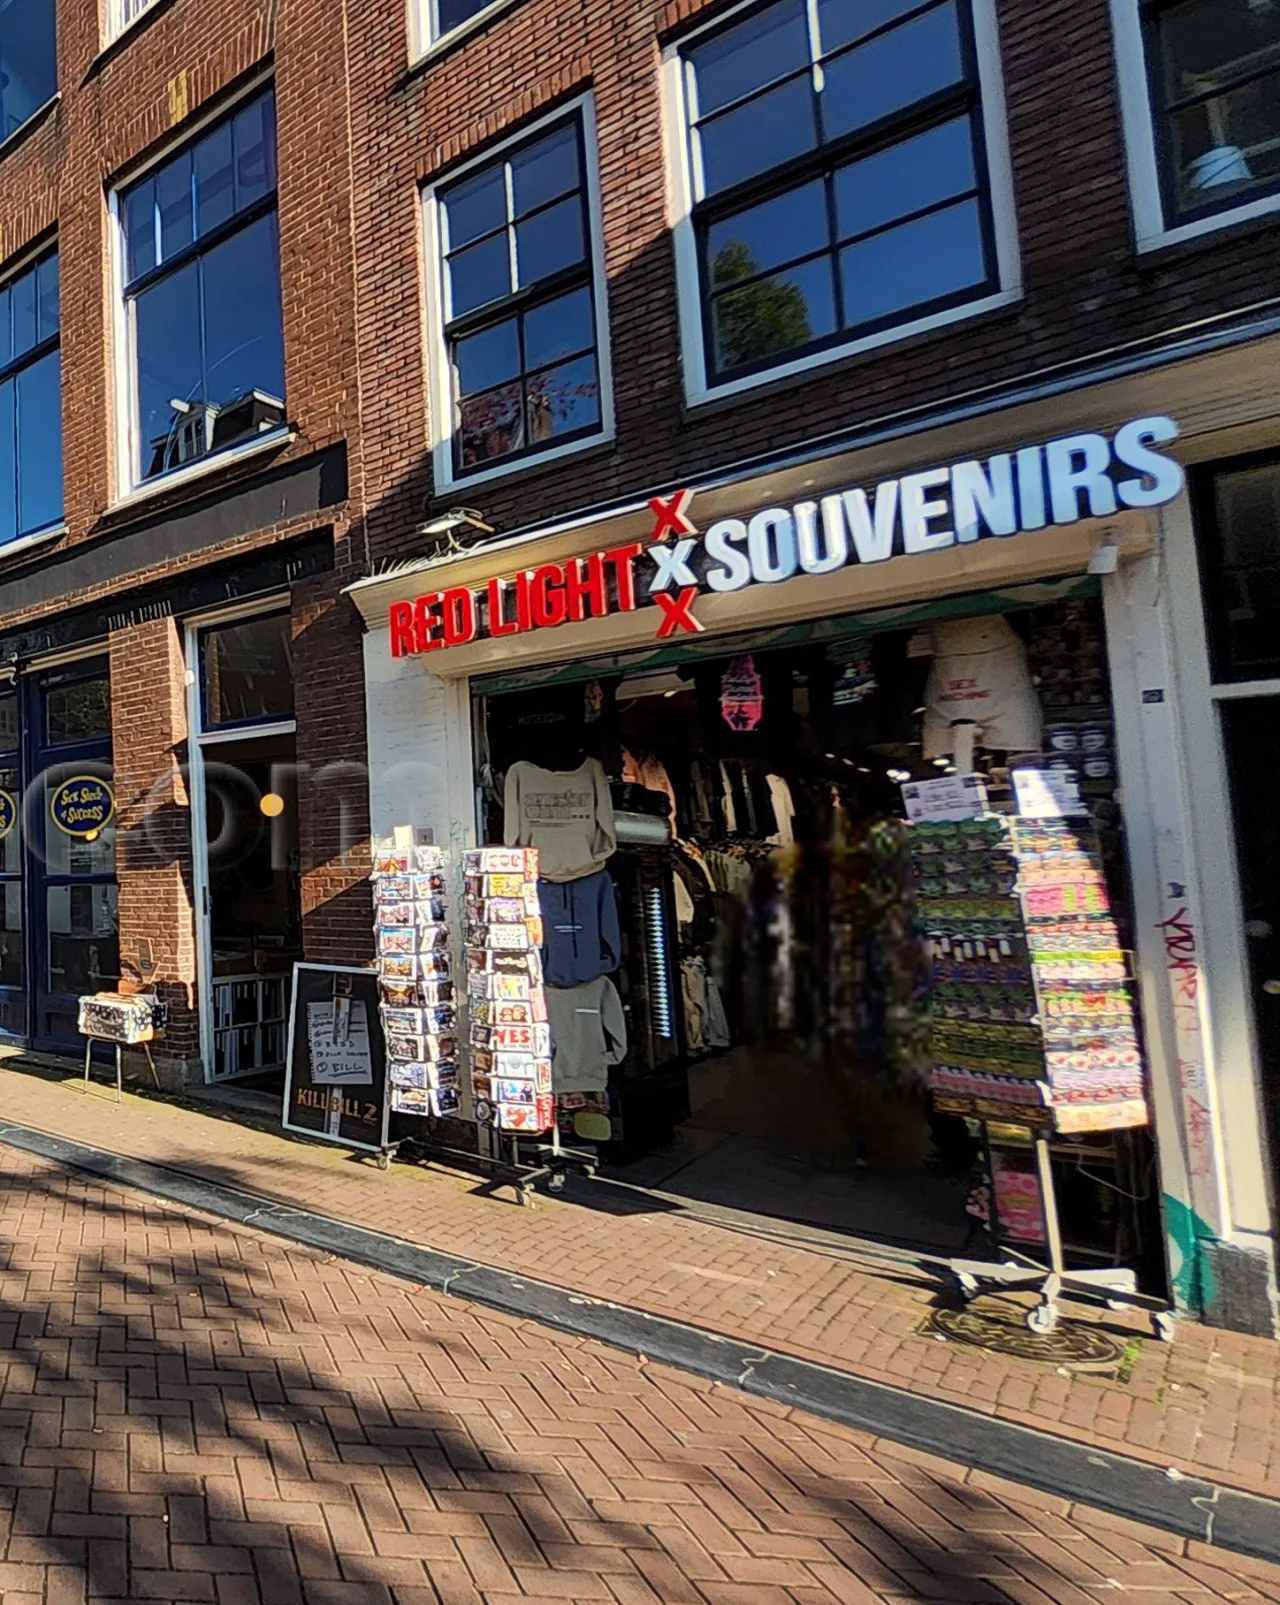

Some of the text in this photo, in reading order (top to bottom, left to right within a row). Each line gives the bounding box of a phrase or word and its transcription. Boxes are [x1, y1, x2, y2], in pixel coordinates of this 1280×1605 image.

[705, 414, 1186, 593] SOUVENIRS
[389, 543, 643, 658] RED LIGHT
[297, 1087, 327, 1110] KILL
[363, 1102, 378, 1121] 2
